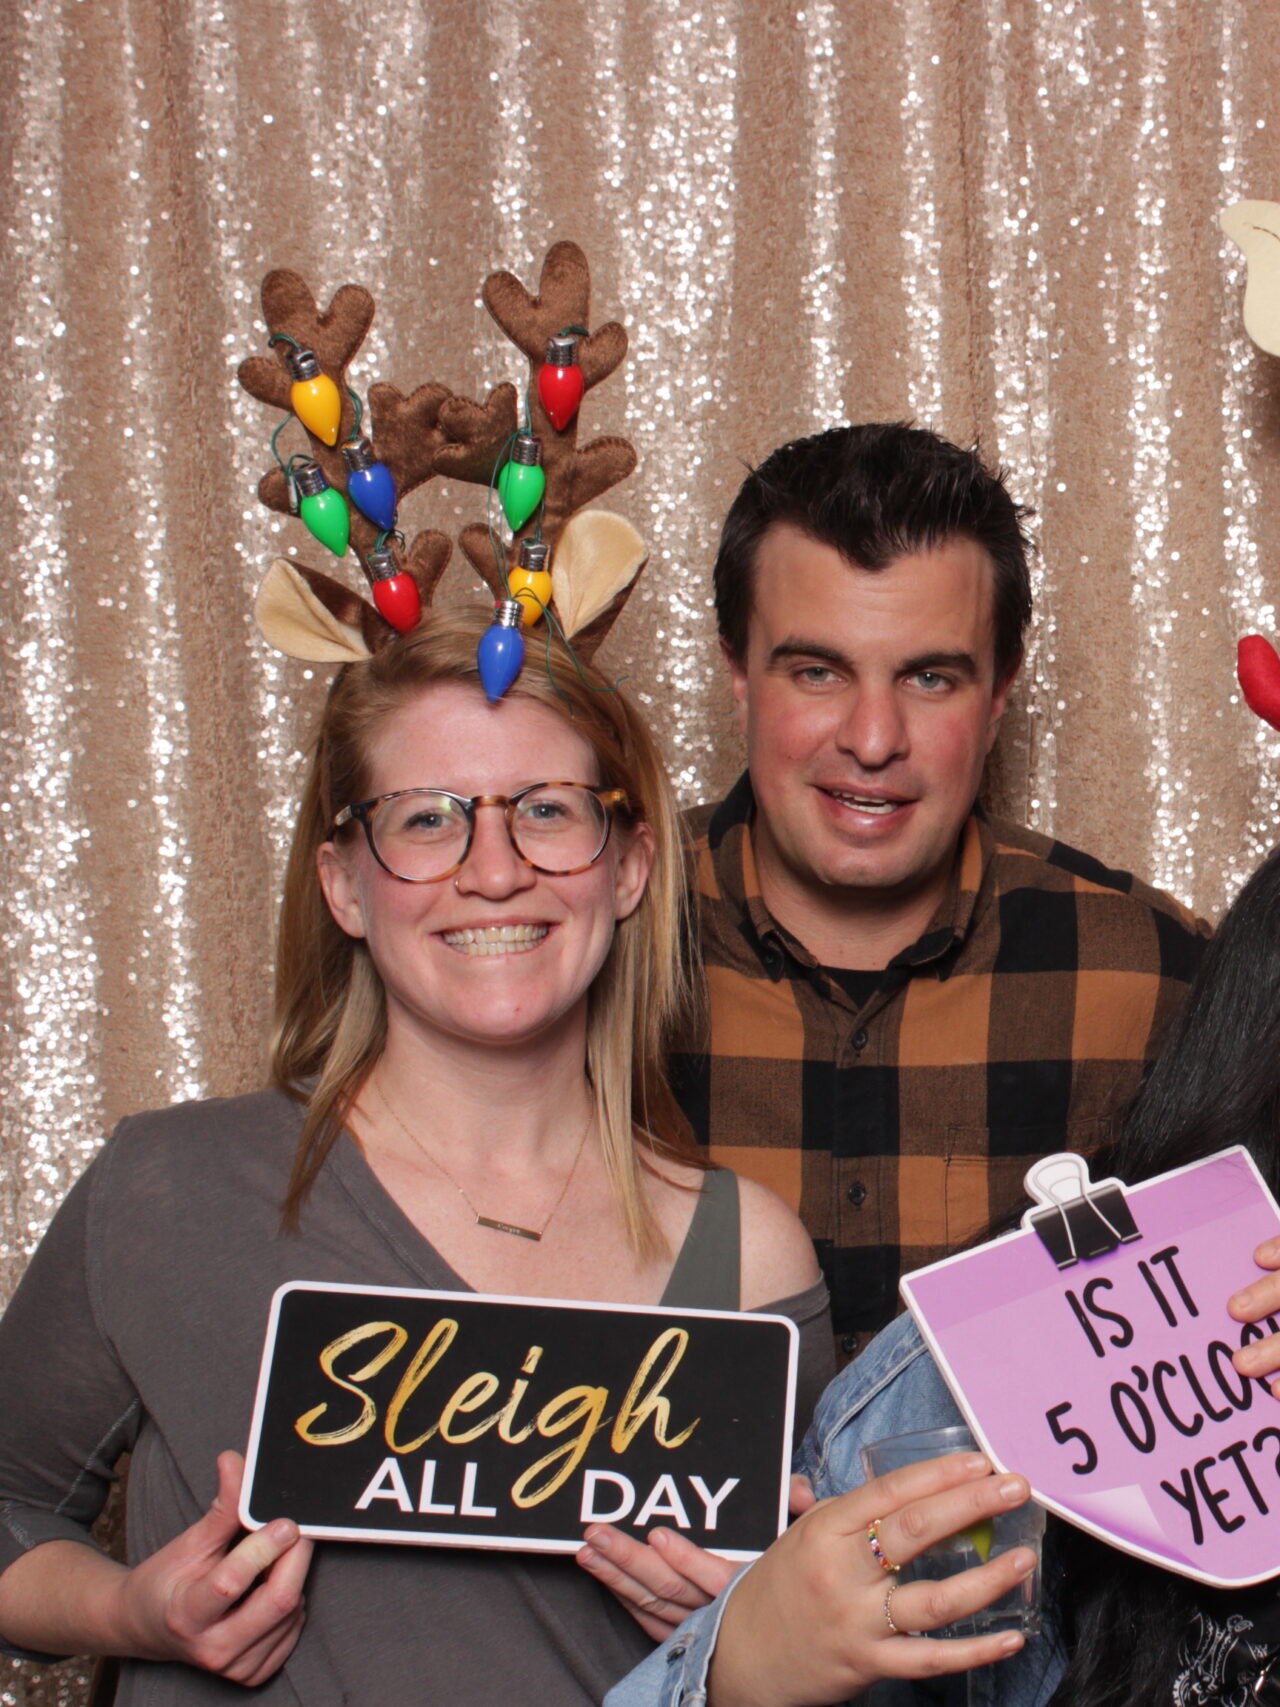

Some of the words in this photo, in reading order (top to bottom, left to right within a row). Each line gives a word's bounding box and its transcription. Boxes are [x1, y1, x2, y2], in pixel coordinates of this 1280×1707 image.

[1064, 1277, 1134, 1358] IS
[1137, 1245, 1199, 1328] IT
[294, 1317, 701, 1508] Sleigh
[1045, 1401, 1098, 1475] 5
[354, 1456, 498, 1518] ALL
[579, 1469, 741, 1531] DAY
